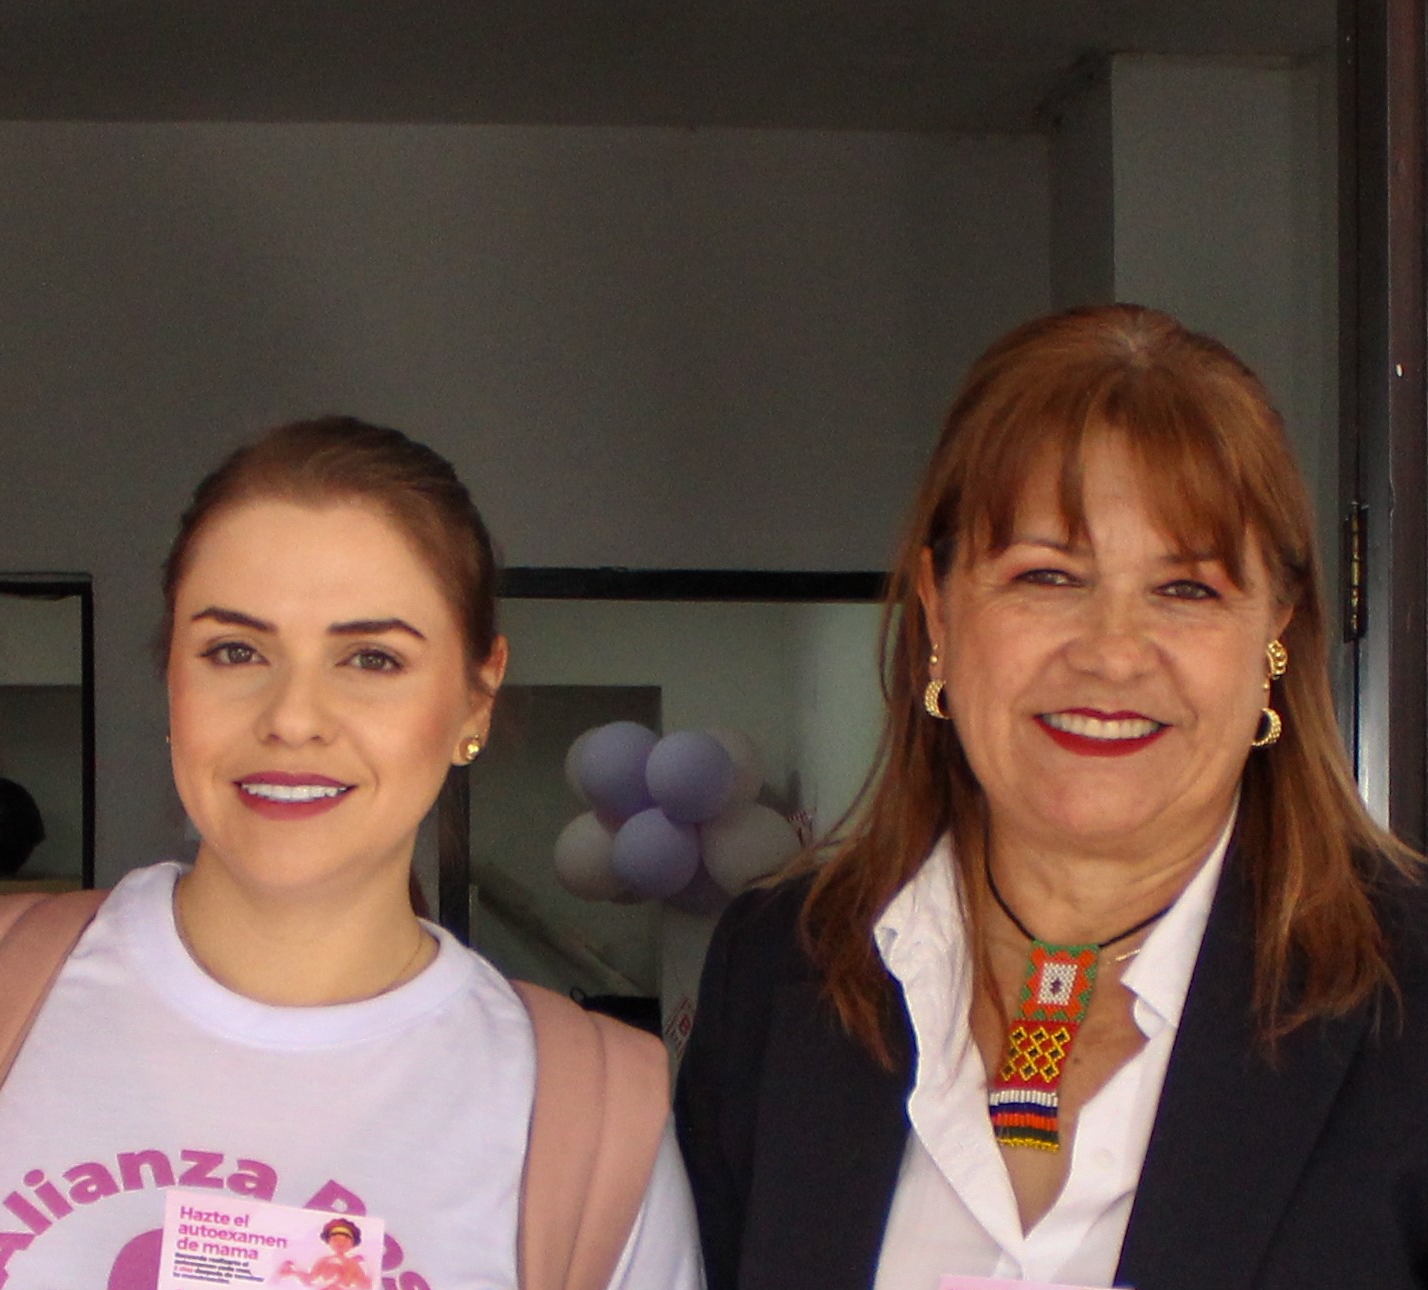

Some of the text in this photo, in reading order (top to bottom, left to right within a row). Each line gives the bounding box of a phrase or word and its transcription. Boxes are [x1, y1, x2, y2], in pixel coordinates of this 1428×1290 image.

[180, 1206, 249, 1228] Hazte el
[178, 1224, 288, 1249] autoexamen
[176, 1237, 259, 1260] de mama
